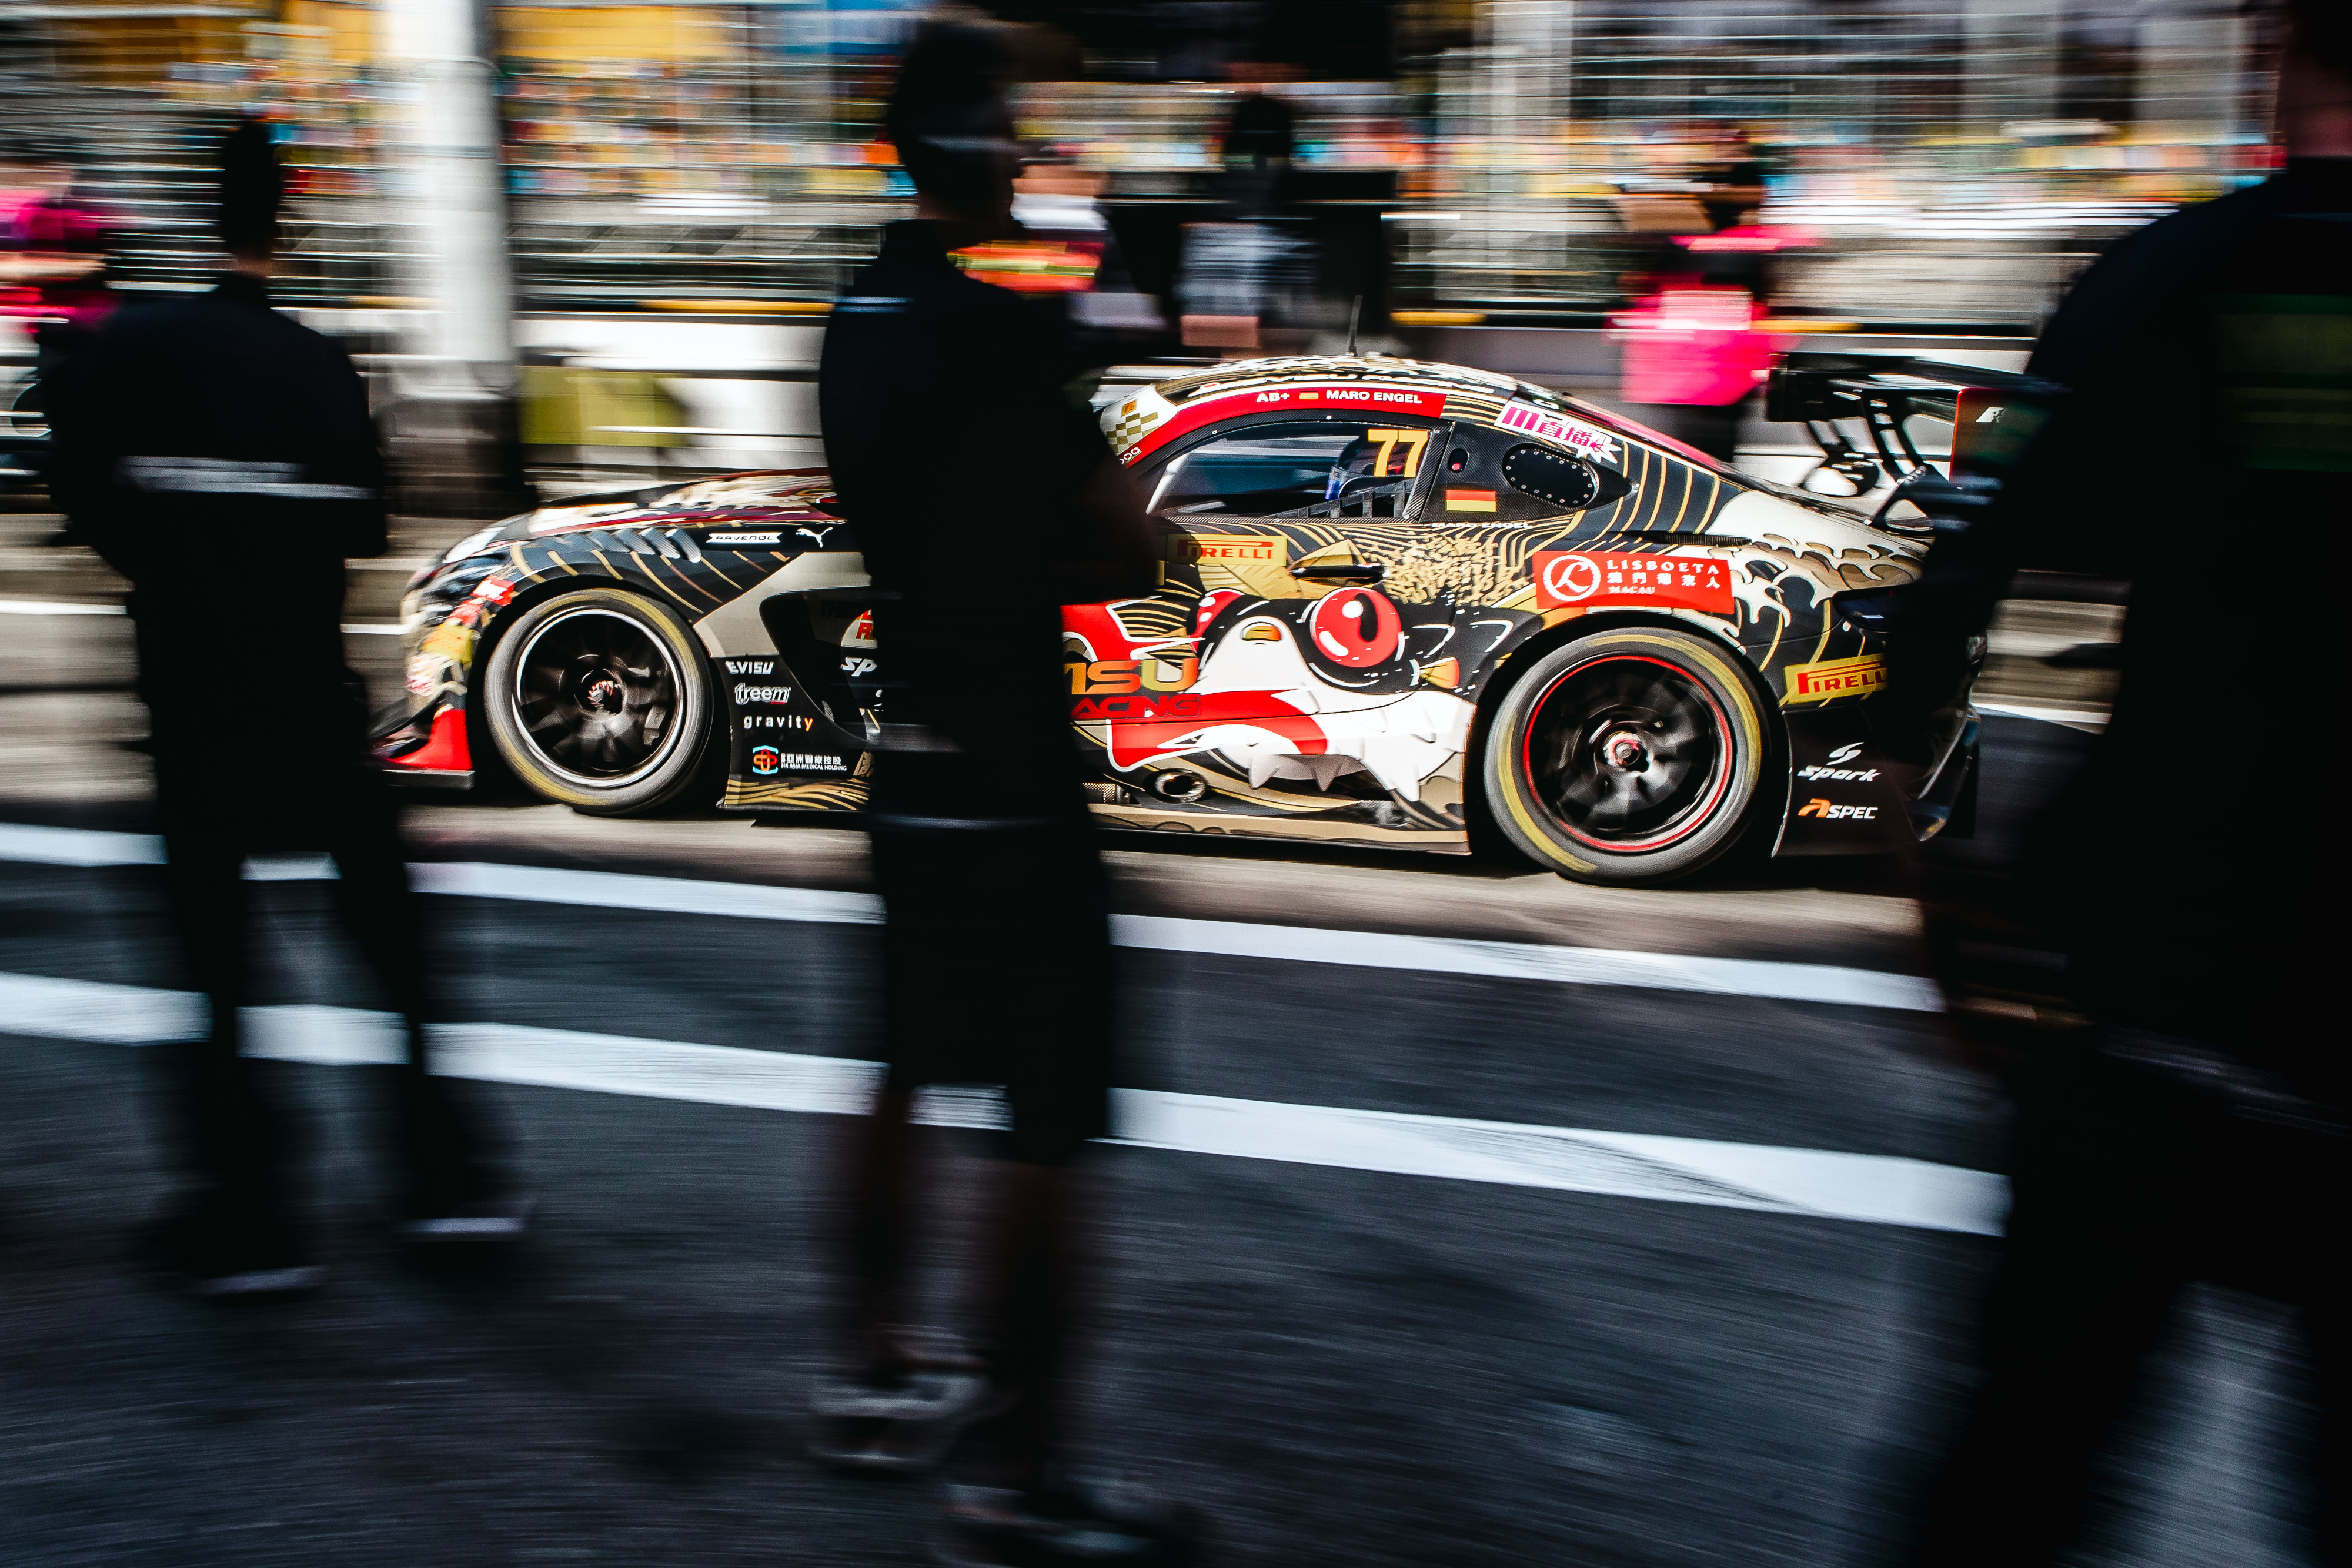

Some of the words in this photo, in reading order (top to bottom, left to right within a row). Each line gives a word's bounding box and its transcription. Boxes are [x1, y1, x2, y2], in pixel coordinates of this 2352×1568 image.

[1256, 392, 1290, 403] AB+
[1326, 390, 1370, 400] MARO
[1374, 392, 1422, 404] ENGEL
[1368, 429, 1429, 477] 77
[1177, 539, 1274, 559] PIRELLI
[1606, 560, 1719, 575] LISBOETA
[1608, 586, 1655, 594] MACAU
[725, 661, 774, 674] EVISU
[1797, 660, 1889, 695] PIRELL
[734, 682, 791, 705] freem
[1070, 694, 1201, 718] ACING
[743, 714, 813, 731] gravity
